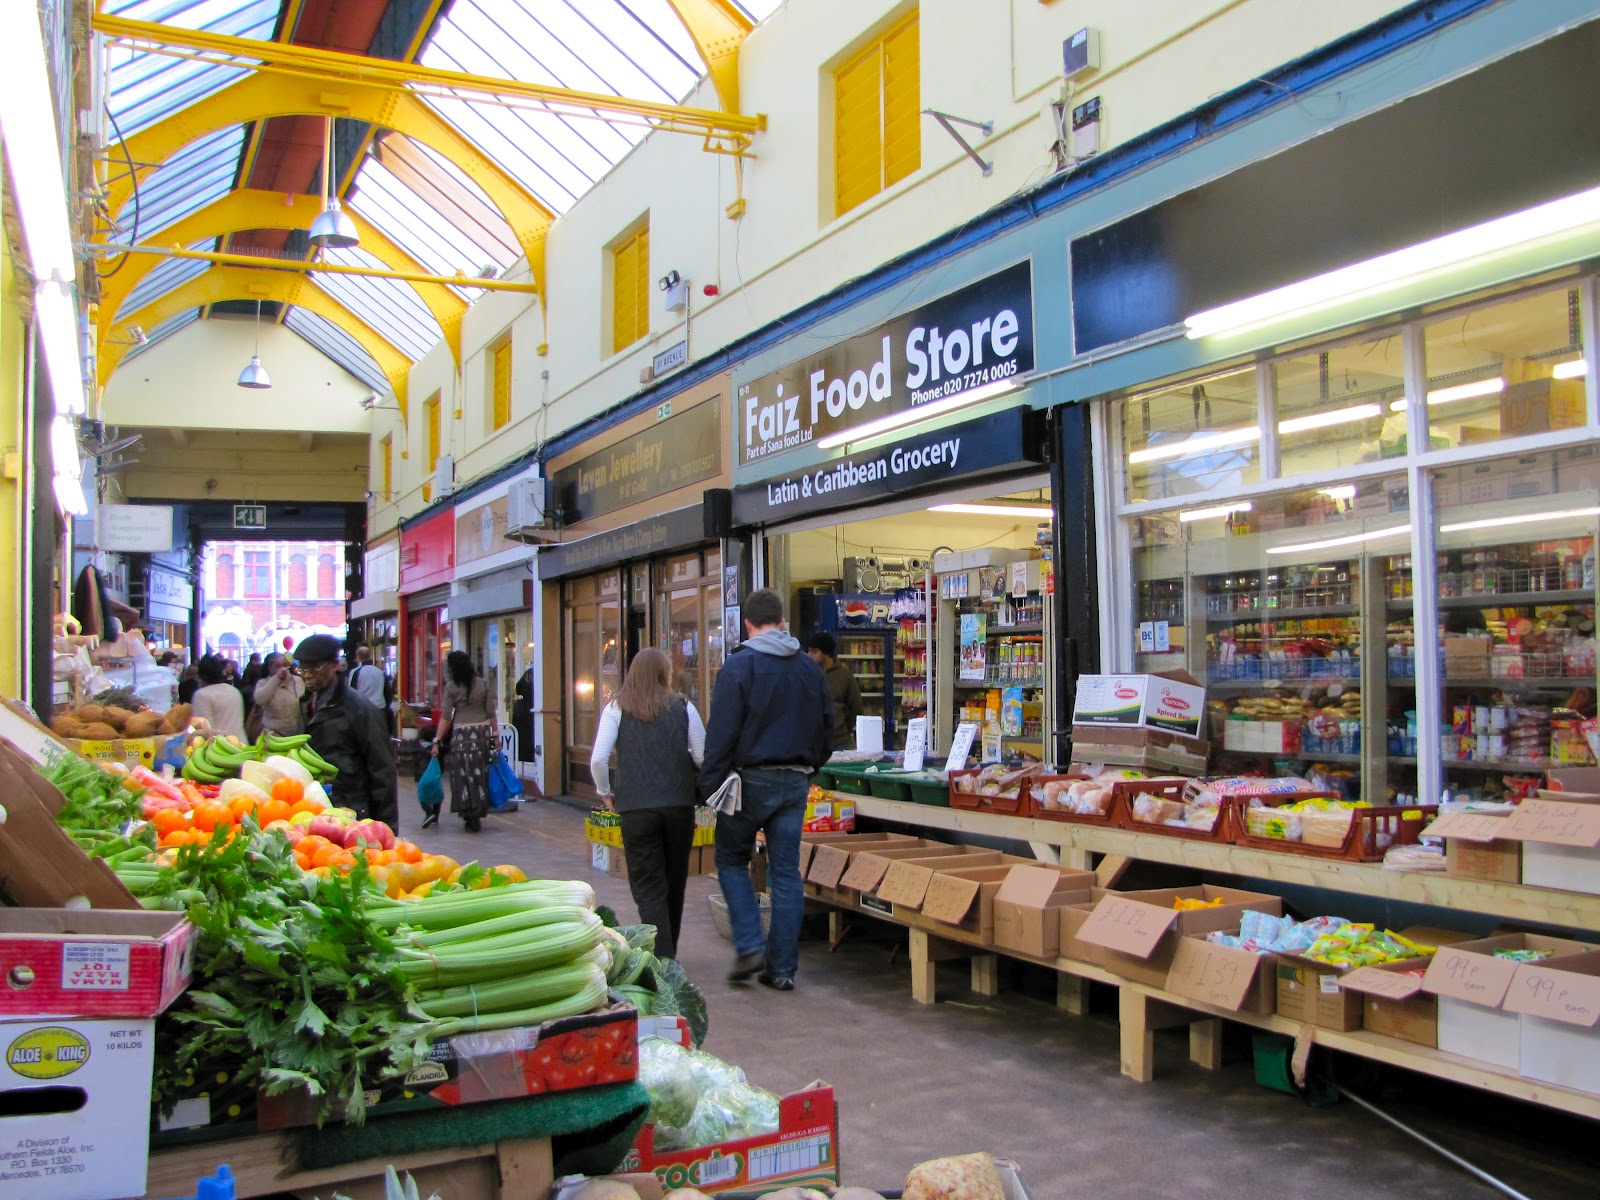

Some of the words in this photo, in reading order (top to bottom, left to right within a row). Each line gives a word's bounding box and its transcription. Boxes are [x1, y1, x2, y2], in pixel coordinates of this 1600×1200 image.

[745, 383, 800, 446] Faiz
[810, 336, 892, 425] Food
[905, 309, 1019, 390] Store
[911, 387, 943, 407] Phone:
[943, 377, 962, 396] 020
[963, 368, 989, 389] 7274
[990, 358, 1018, 380] 0005
[746, 447, 760, 461] Part
[759, 443, 768, 456] of
[767, 439, 783, 454] Sana
[783, 431, 800, 449] food
[800, 426, 813, 443] Ltd
[609, 440, 663, 483] Jewellery
[768, 478, 799, 507] Latin
[802, 474, 812, 498] &
[814, 459, 887, 495] Caribbean
[891, 438, 961, 476] Grocery
[1156, 708, 1177, 718] Spiced
[1178, 713, 1191, 721] Bun
[11, 1047, 41, 1064] ALOE
[57, 1045, 87, 1062] KING
[412, 1071, 446, 1081] FLANDRIA
[16, 1140, 24, 1148] A
[25, 1137, 59, 1148] Division
[61, 1135, 70, 1145] of
[30, 1147, 55, 1157] Fields
[57, 1145, 78, 1154] Aloe,
[80, 1144, 96, 1152] Inc.
[31, 1158, 48, 1167] Box
[51, 1155, 72, 1165] 1330
[44, 1166, 57, 1176] TX
[59, 1164, 85, 1175] 78570
